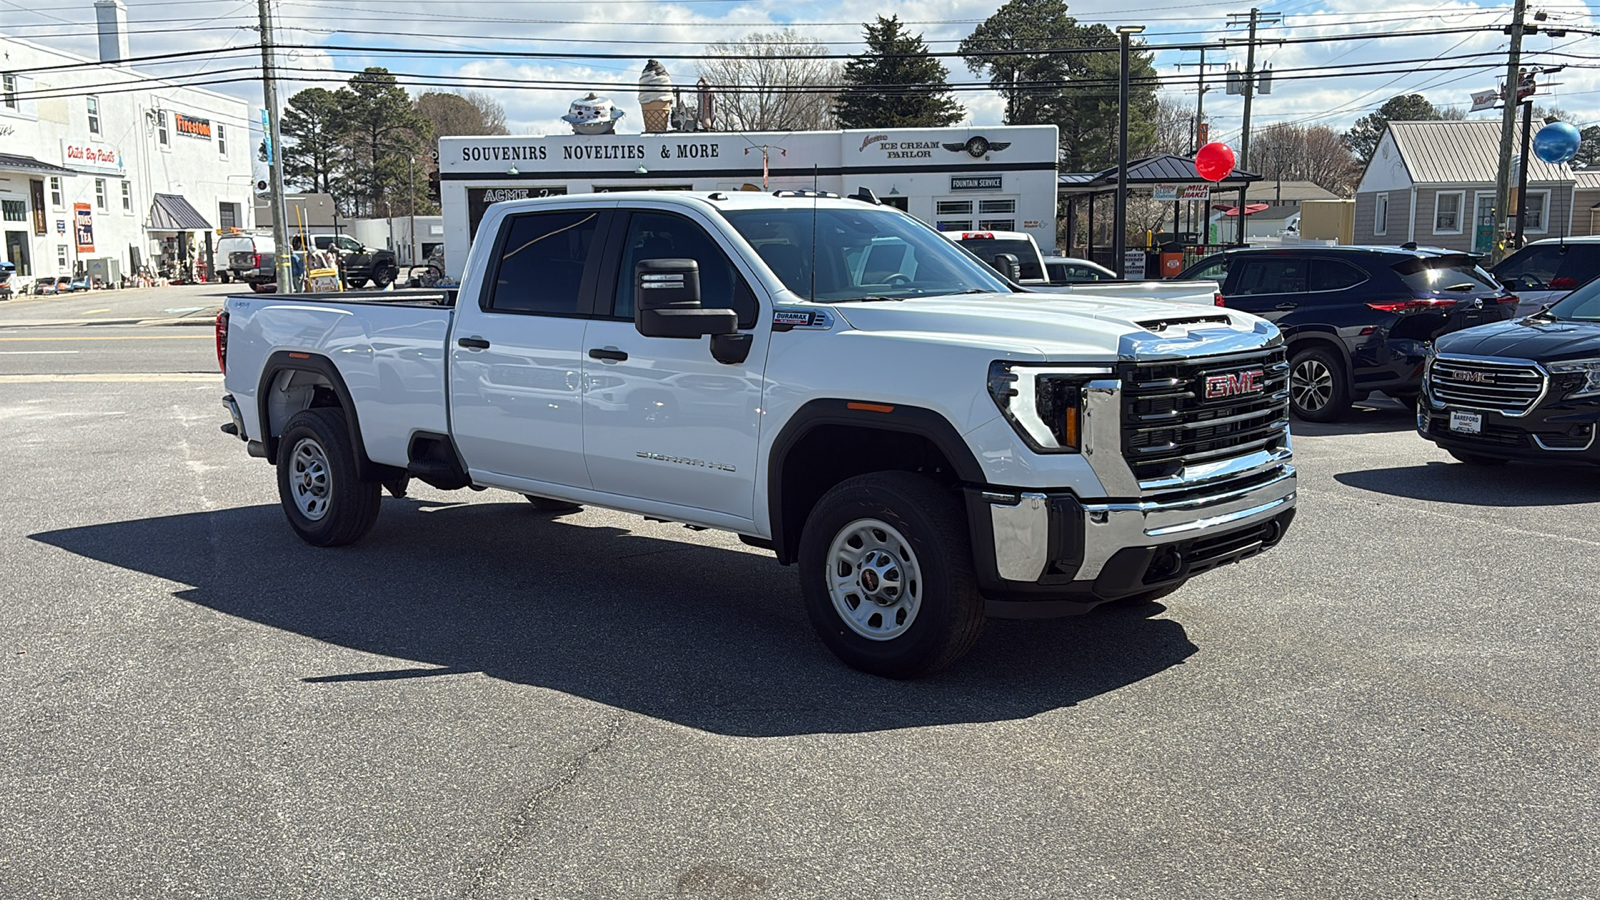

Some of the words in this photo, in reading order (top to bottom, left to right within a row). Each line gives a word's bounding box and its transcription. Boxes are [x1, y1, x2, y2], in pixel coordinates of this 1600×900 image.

[175, 114, 211, 136] Firestone
[462, 146, 547, 161] SOUVENIRS
[563, 145, 645, 160] NOVELTIES
[660, 144, 671, 159] &
[676, 143, 719, 158] MORE
[880, 142, 898, 150] ICE
[900, 141, 940, 150] CREAM
[67, 145, 84, 159] Dutch
[86, 147, 97, 164] Boy
[97, 149, 115, 163] Paints
[887, 150, 932, 159] PARLOR
[952, 180, 979, 188] FOUNTAIN
[979, 179, 1000, 187] SERVICE
[484, 189, 529, 202] ACME
[777, 312, 807, 320] DURAMAX
[1452, 370, 1496, 383] GMC
[1205, 370, 1264, 399] GMC
[1454, 414, 1479, 423] BAREFORD
[636, 451, 705, 467] SIERRA
[708, 461, 737, 472] HD
